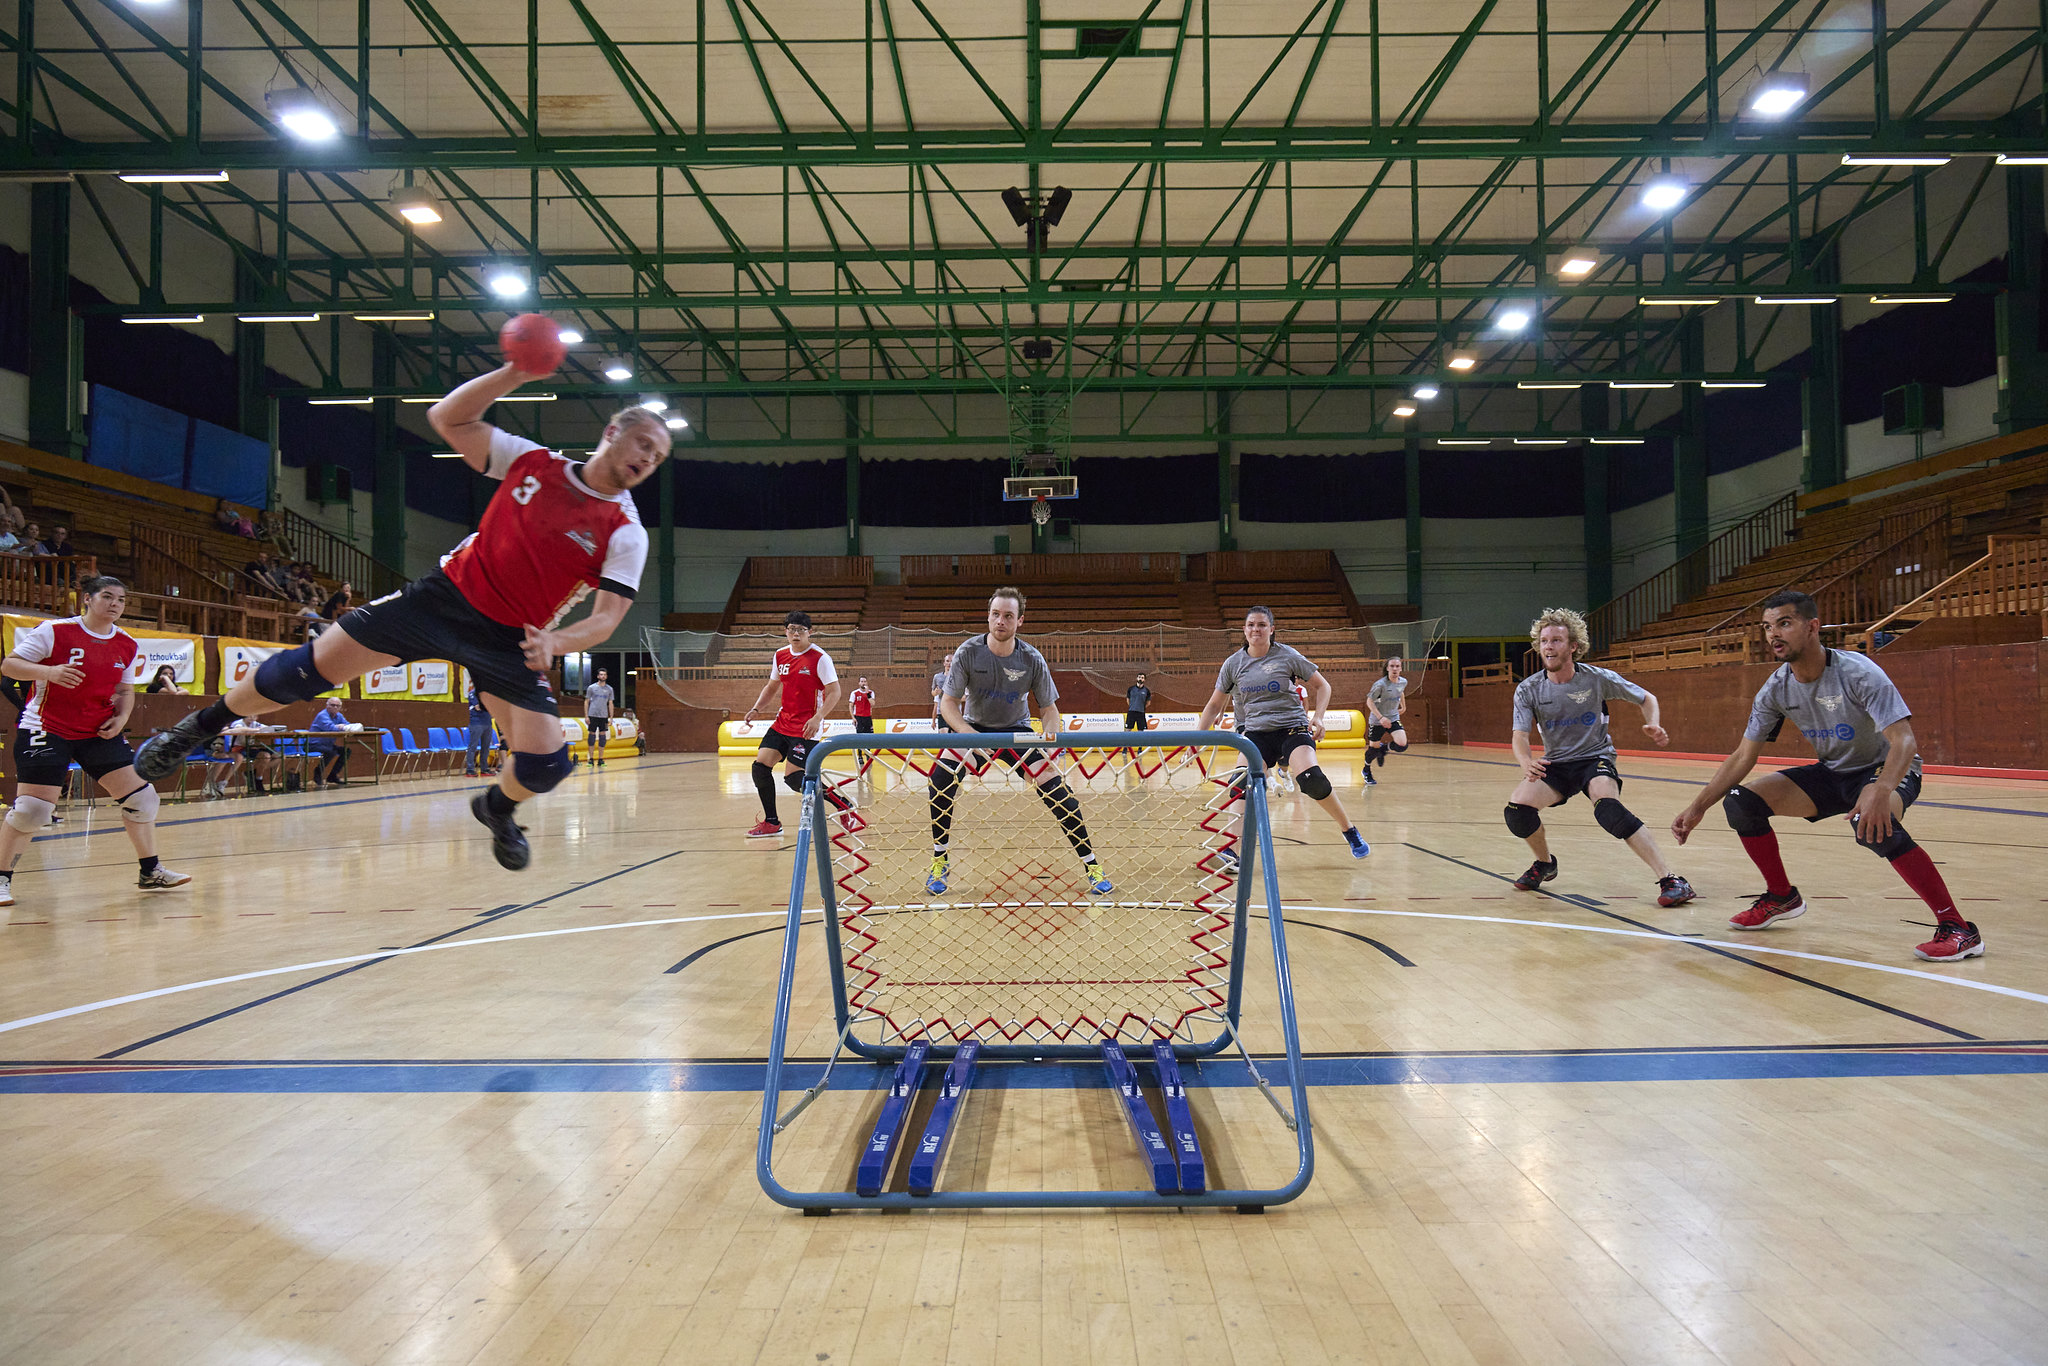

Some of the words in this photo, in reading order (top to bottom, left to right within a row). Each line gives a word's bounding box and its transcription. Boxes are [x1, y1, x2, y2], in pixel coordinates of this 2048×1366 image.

[511, 475, 542, 505] 3
[69, 648, 85, 666] 2
[149, 652, 187, 661] tchoukball
